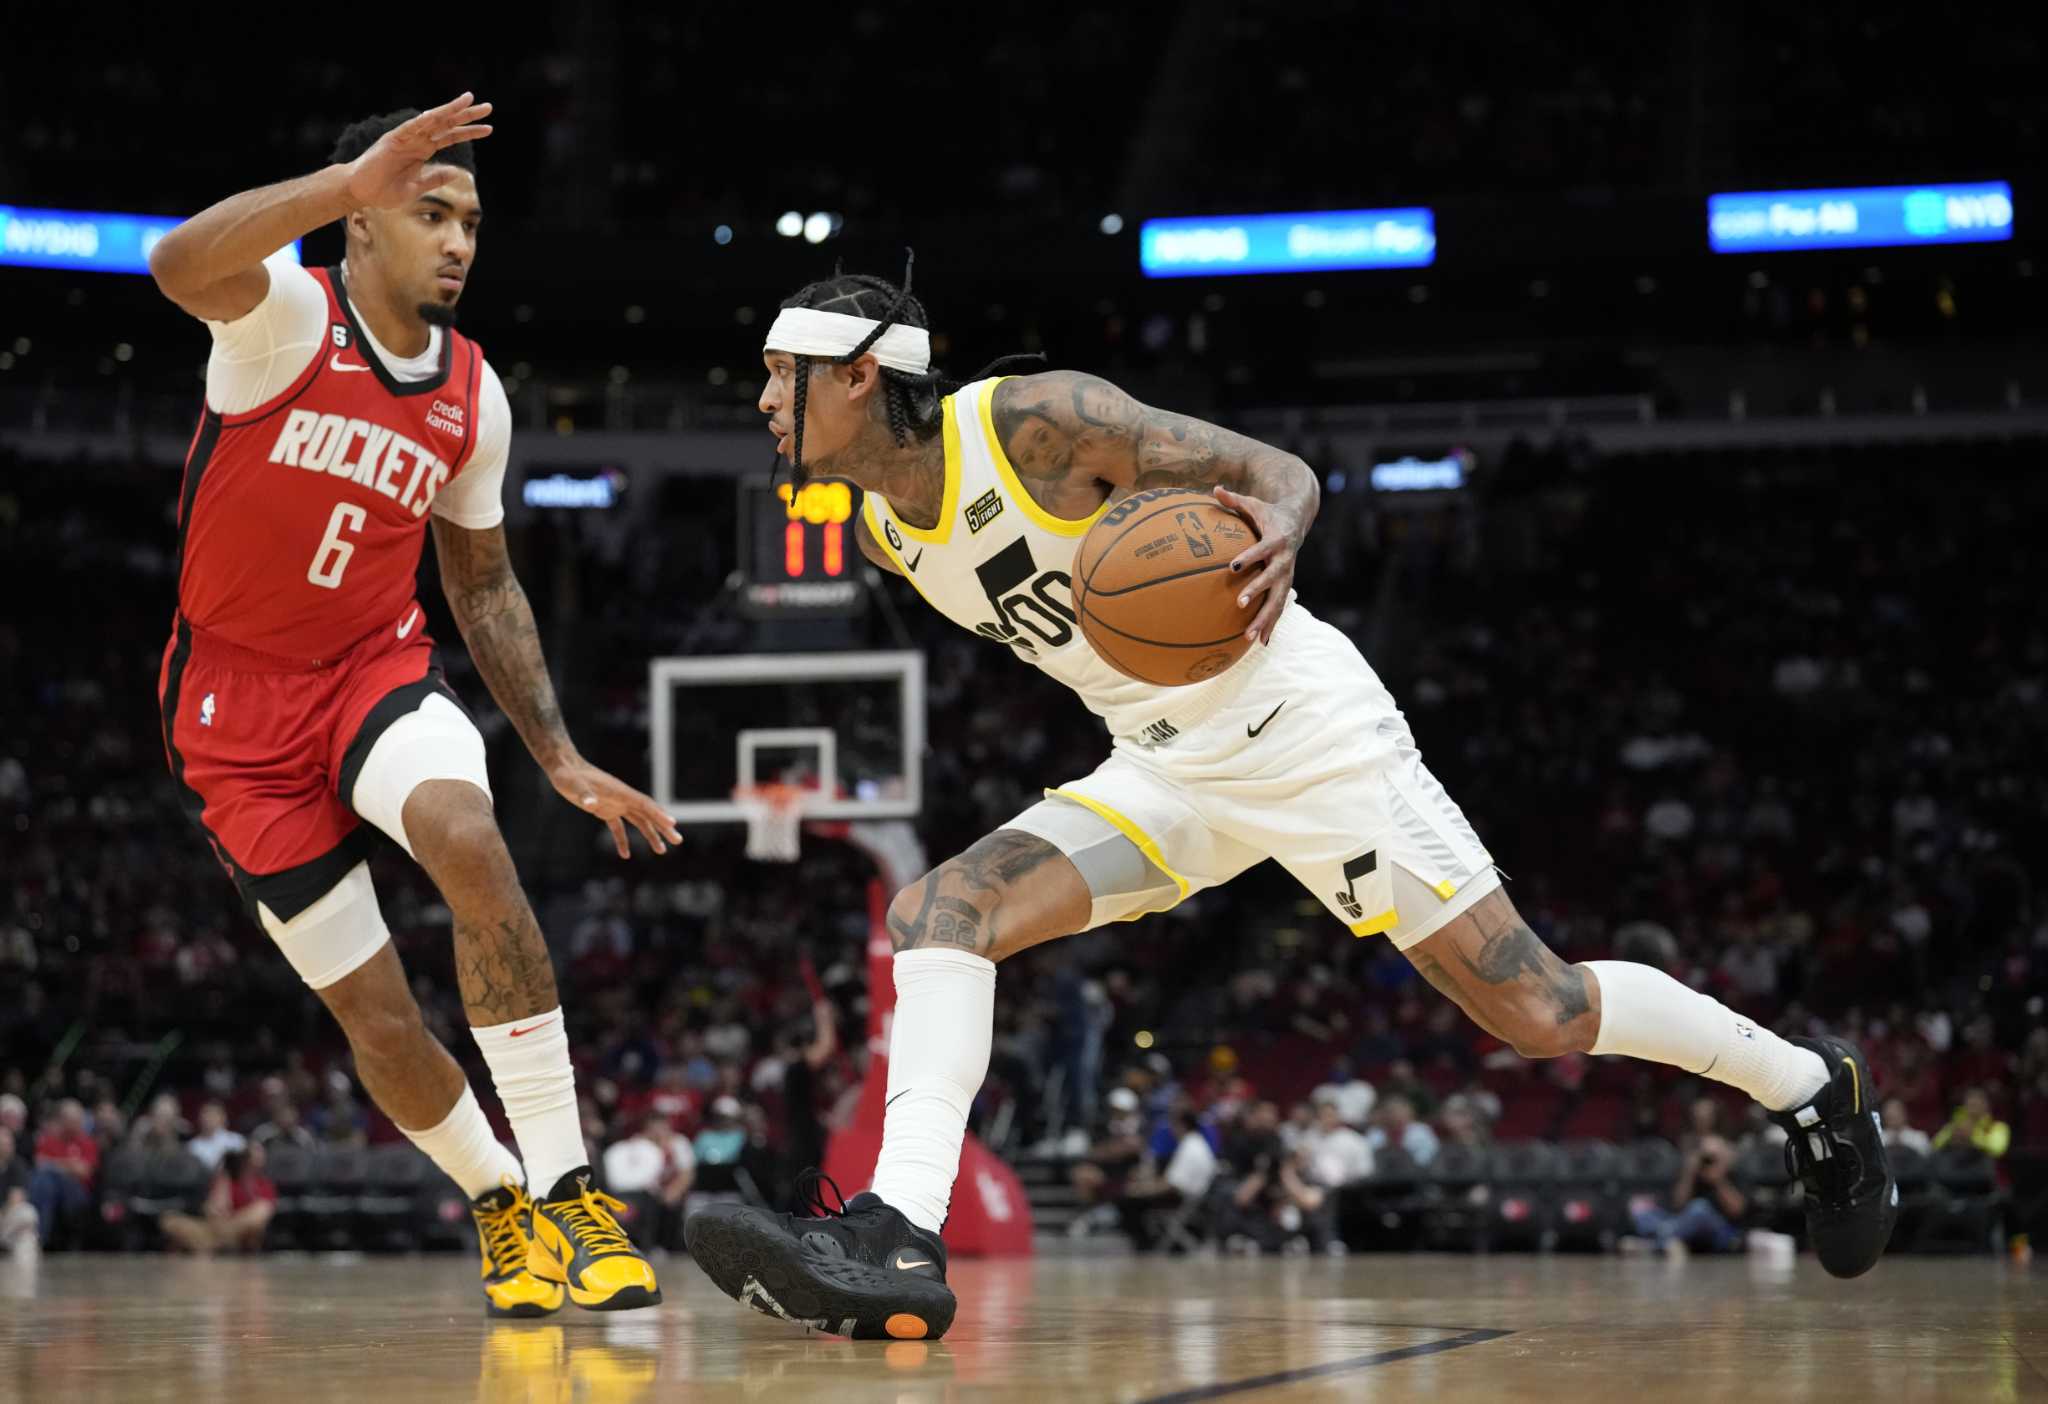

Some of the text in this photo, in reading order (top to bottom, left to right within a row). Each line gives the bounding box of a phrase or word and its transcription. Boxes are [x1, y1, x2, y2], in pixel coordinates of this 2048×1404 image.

[332, 325, 348, 348] 6
[425, 408, 464, 438] karma
[432, 399, 464, 423] credit
[268, 408, 450, 518] ROCKETS
[966, 507, 981, 534] 5
[979, 501, 1002, 524] FIGHT
[306, 501, 368, 590] 6
